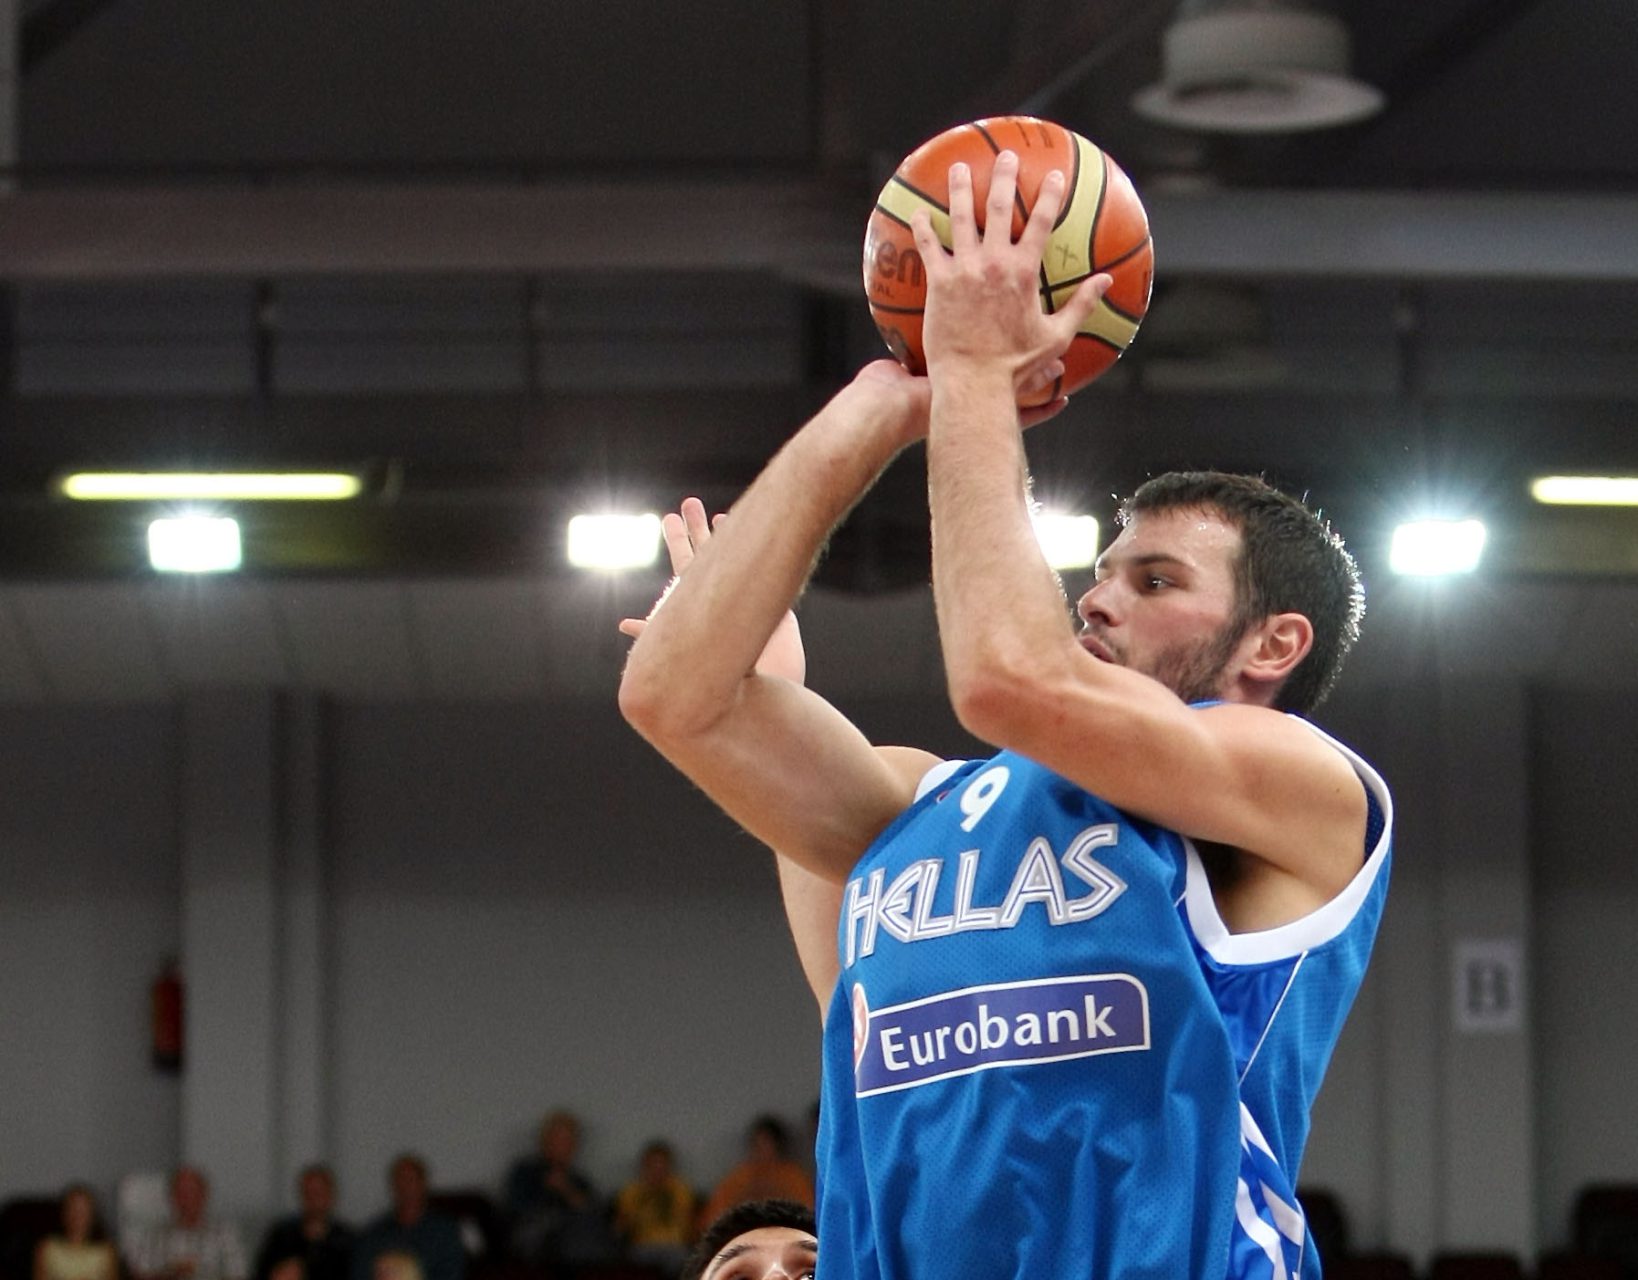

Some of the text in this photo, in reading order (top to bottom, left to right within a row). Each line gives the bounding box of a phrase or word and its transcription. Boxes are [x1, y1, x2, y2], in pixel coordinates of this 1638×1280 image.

[960, 766, 1010, 832] 9
[845, 823, 1128, 969] HELLAS
[880, 994, 1117, 1071] Eurobank
